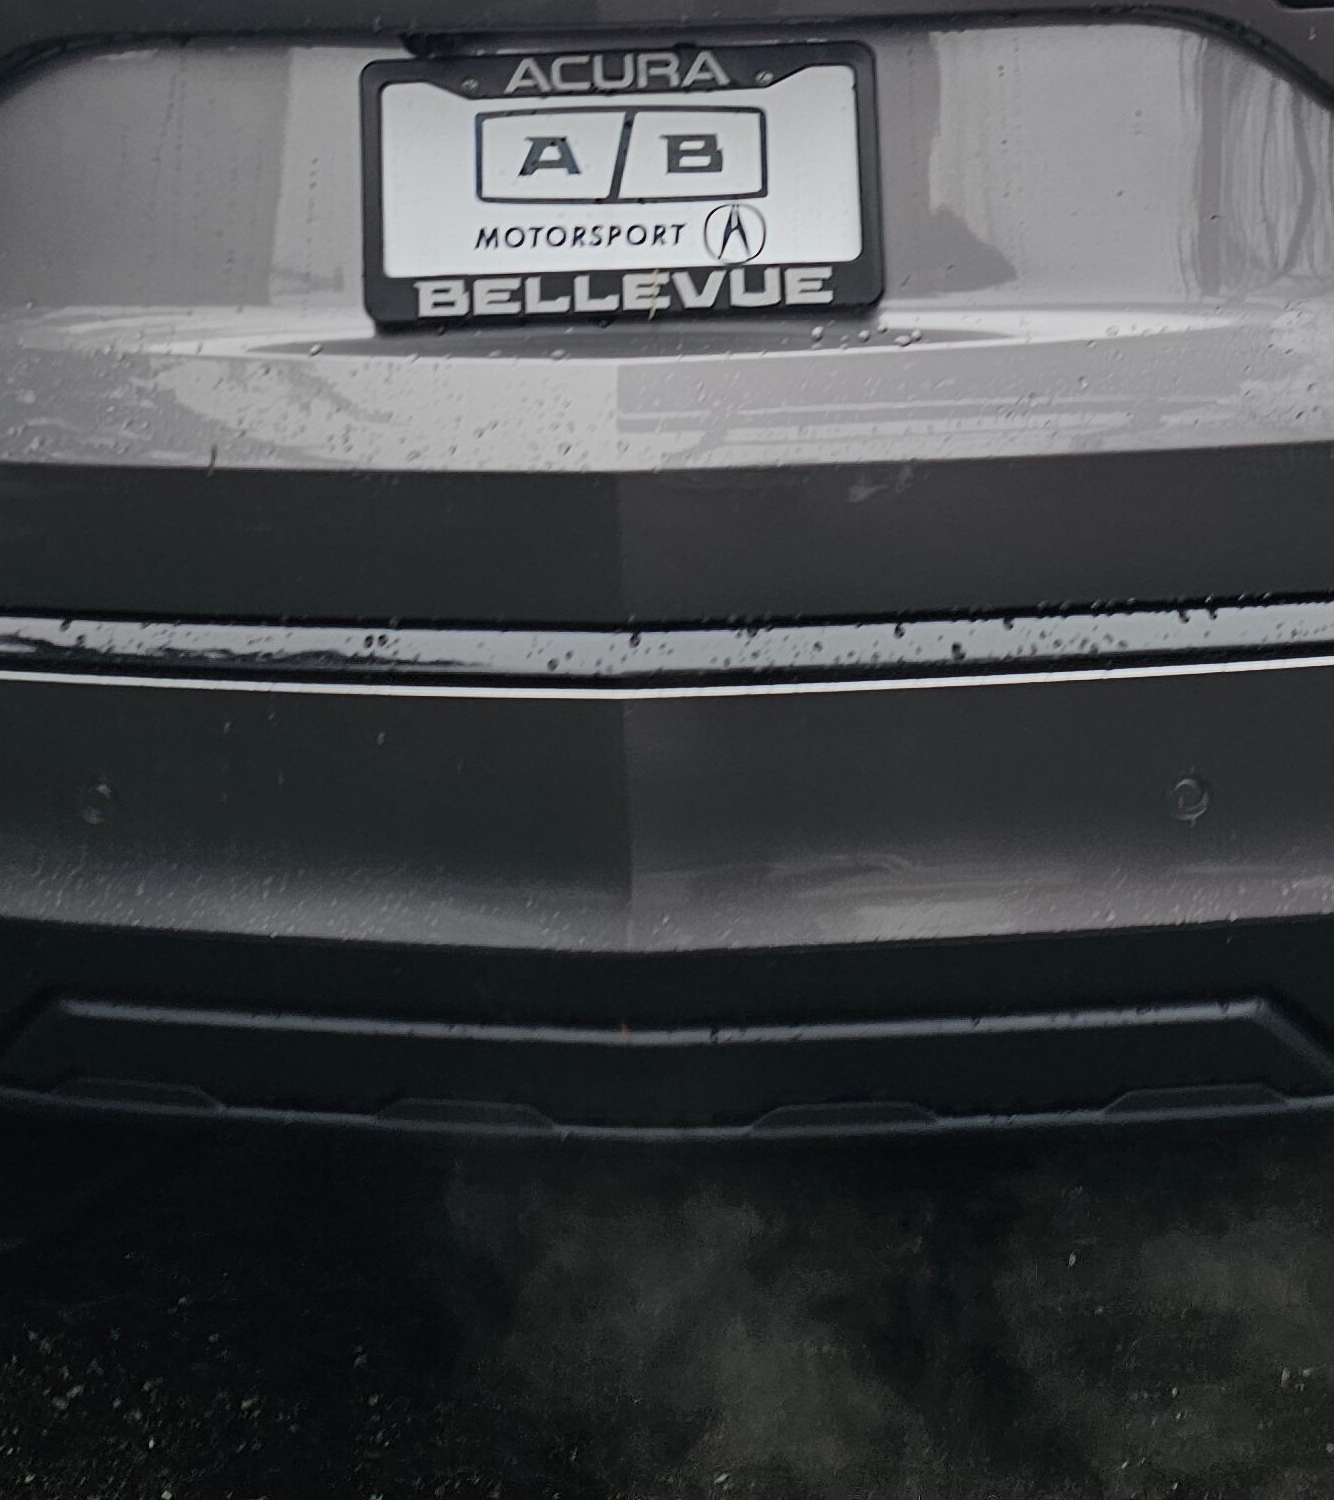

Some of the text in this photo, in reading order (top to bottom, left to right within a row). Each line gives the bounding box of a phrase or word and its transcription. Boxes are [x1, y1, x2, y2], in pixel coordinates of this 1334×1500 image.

[504, 51, 730, 95] ACURA
[518, 133, 724, 177] A B
[474, 222, 688, 251] MOTORSPORT
[413, 266, 835, 318] BELLEVUE
